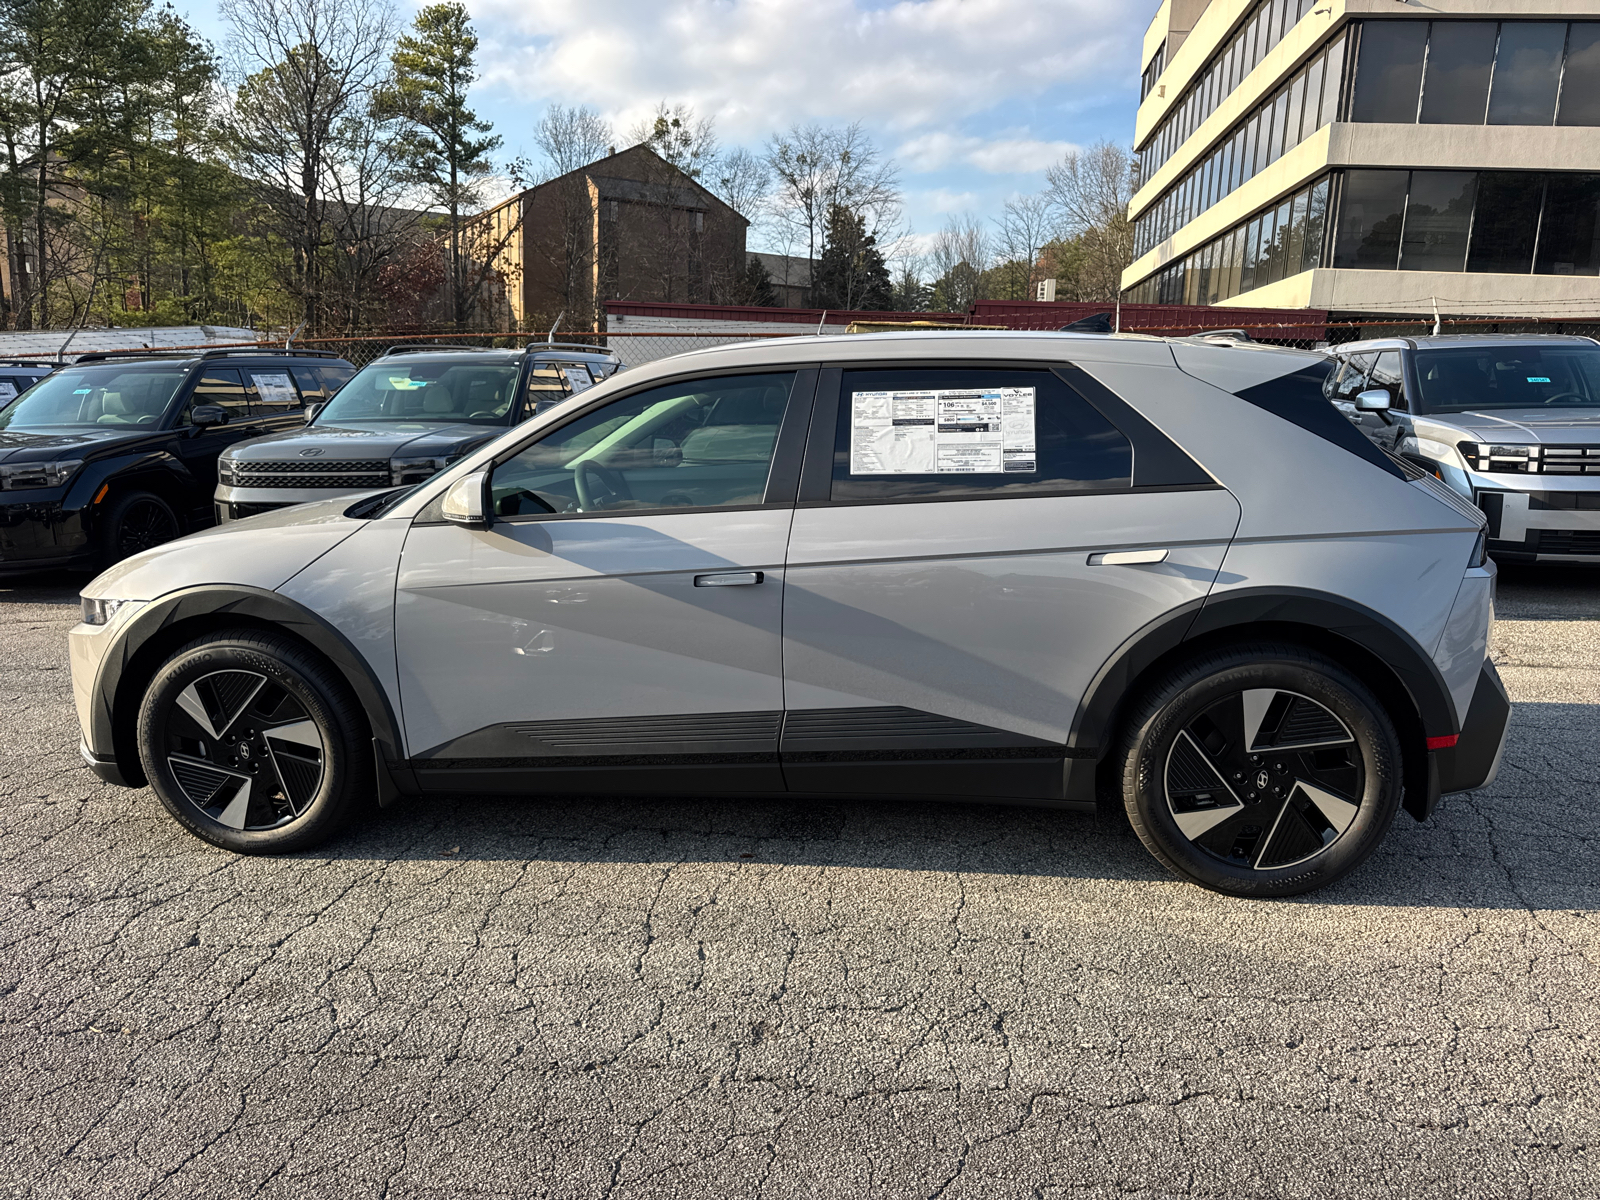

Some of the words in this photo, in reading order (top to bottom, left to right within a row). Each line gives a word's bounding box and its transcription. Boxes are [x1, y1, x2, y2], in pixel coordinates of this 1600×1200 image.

[166, 653, 213, 683] KUMHO
[1208, 668, 1277, 688] KUMHO
[1354, 787, 1388, 852] CRUGEN
